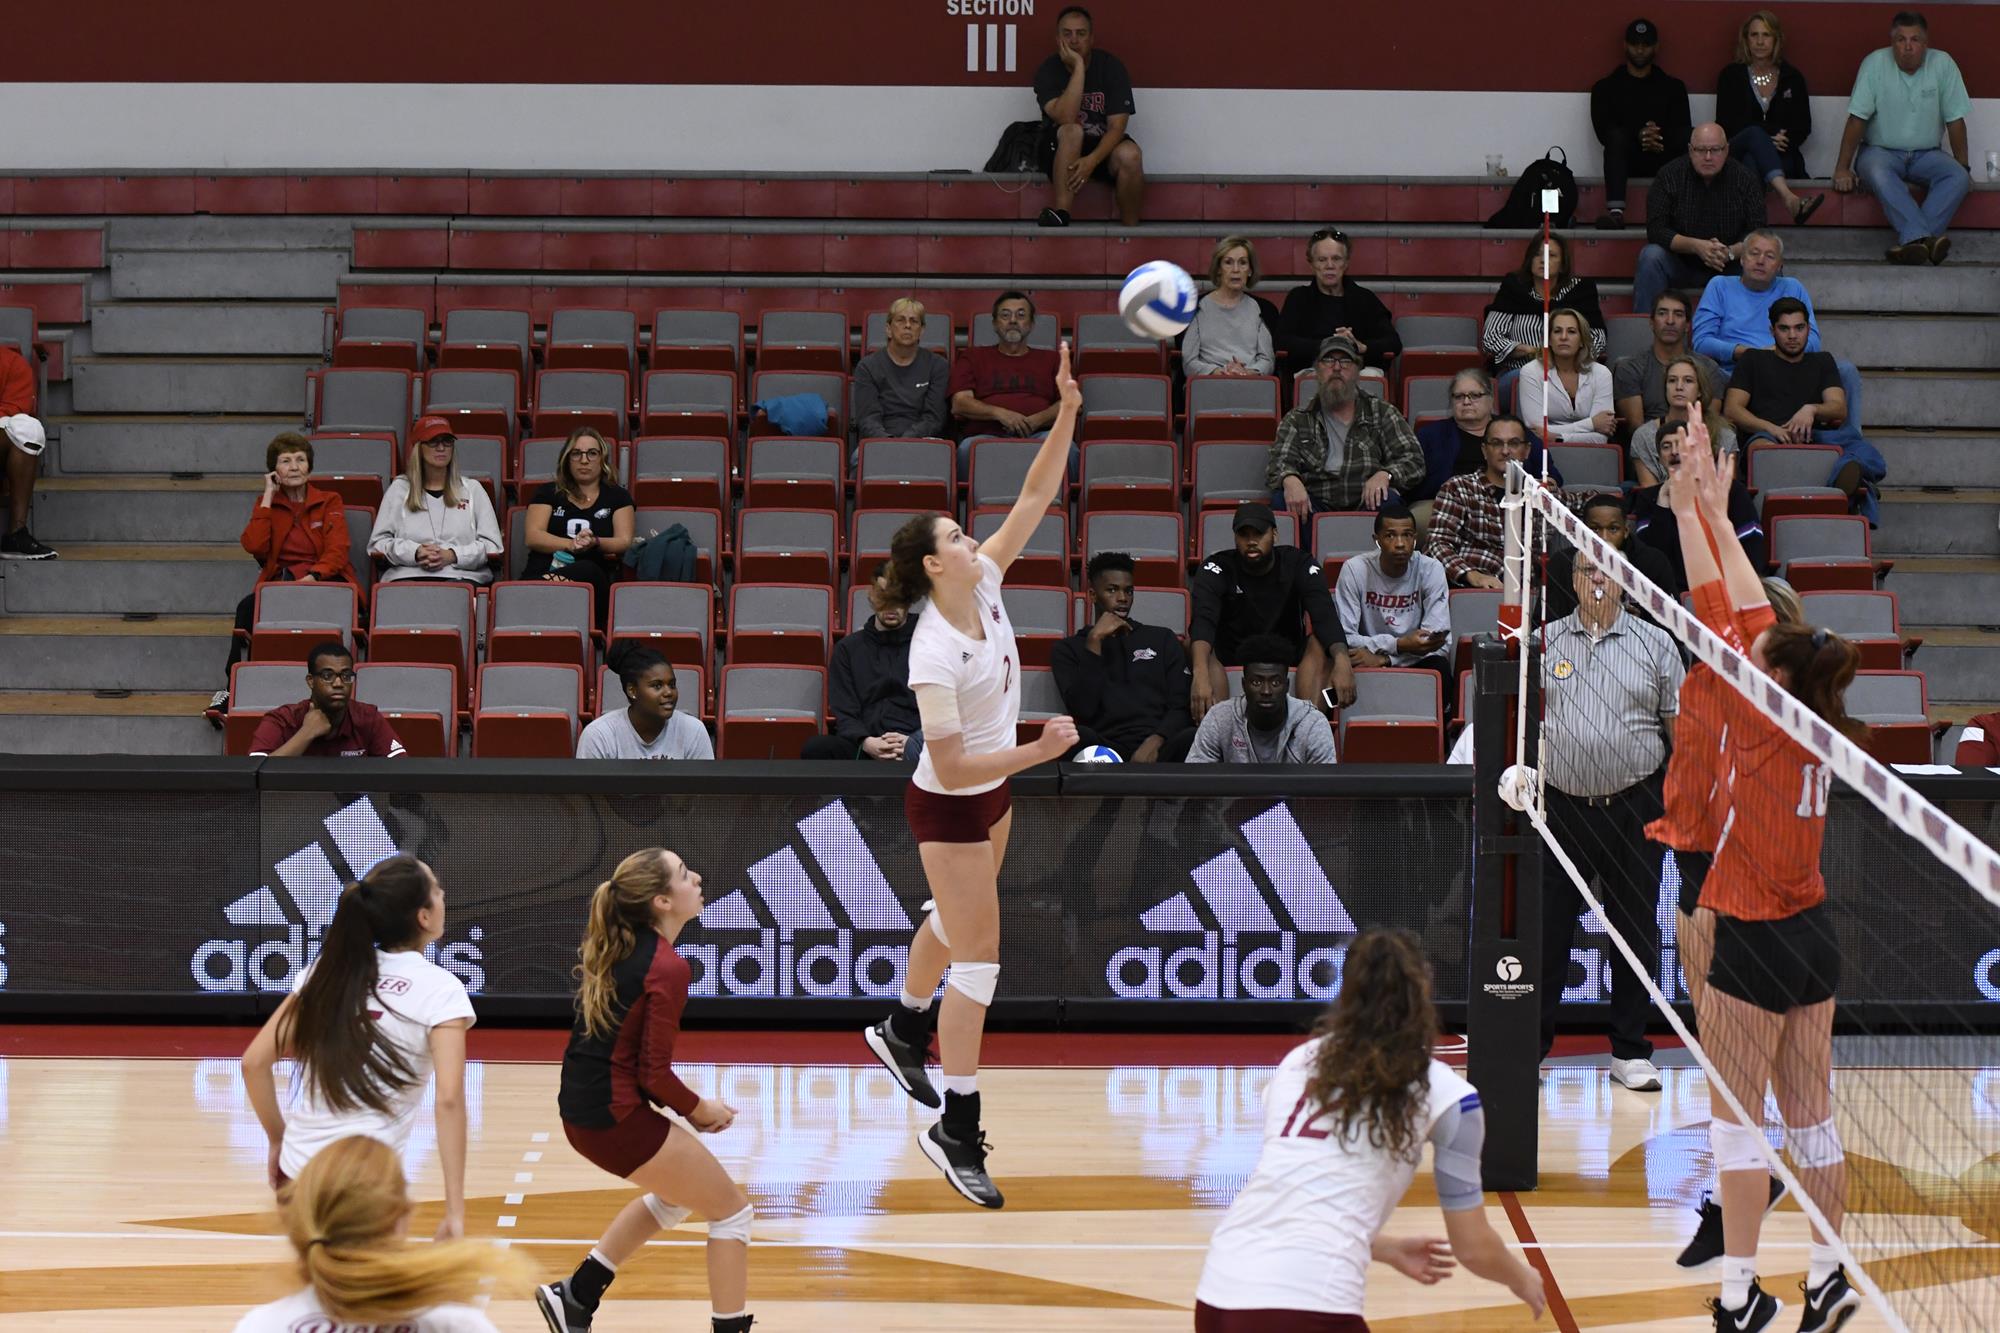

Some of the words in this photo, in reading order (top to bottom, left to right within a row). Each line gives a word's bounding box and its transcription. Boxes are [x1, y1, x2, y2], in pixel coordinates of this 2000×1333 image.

[946, 0, 1034, 15] SECTION
[967, 24, 1017, 72] III
[1365, 591, 1419, 609] RIDER
[1003, 655, 1013, 694] 2
[674, 928, 951, 996] adida
[1106, 931, 1348, 998] adida
